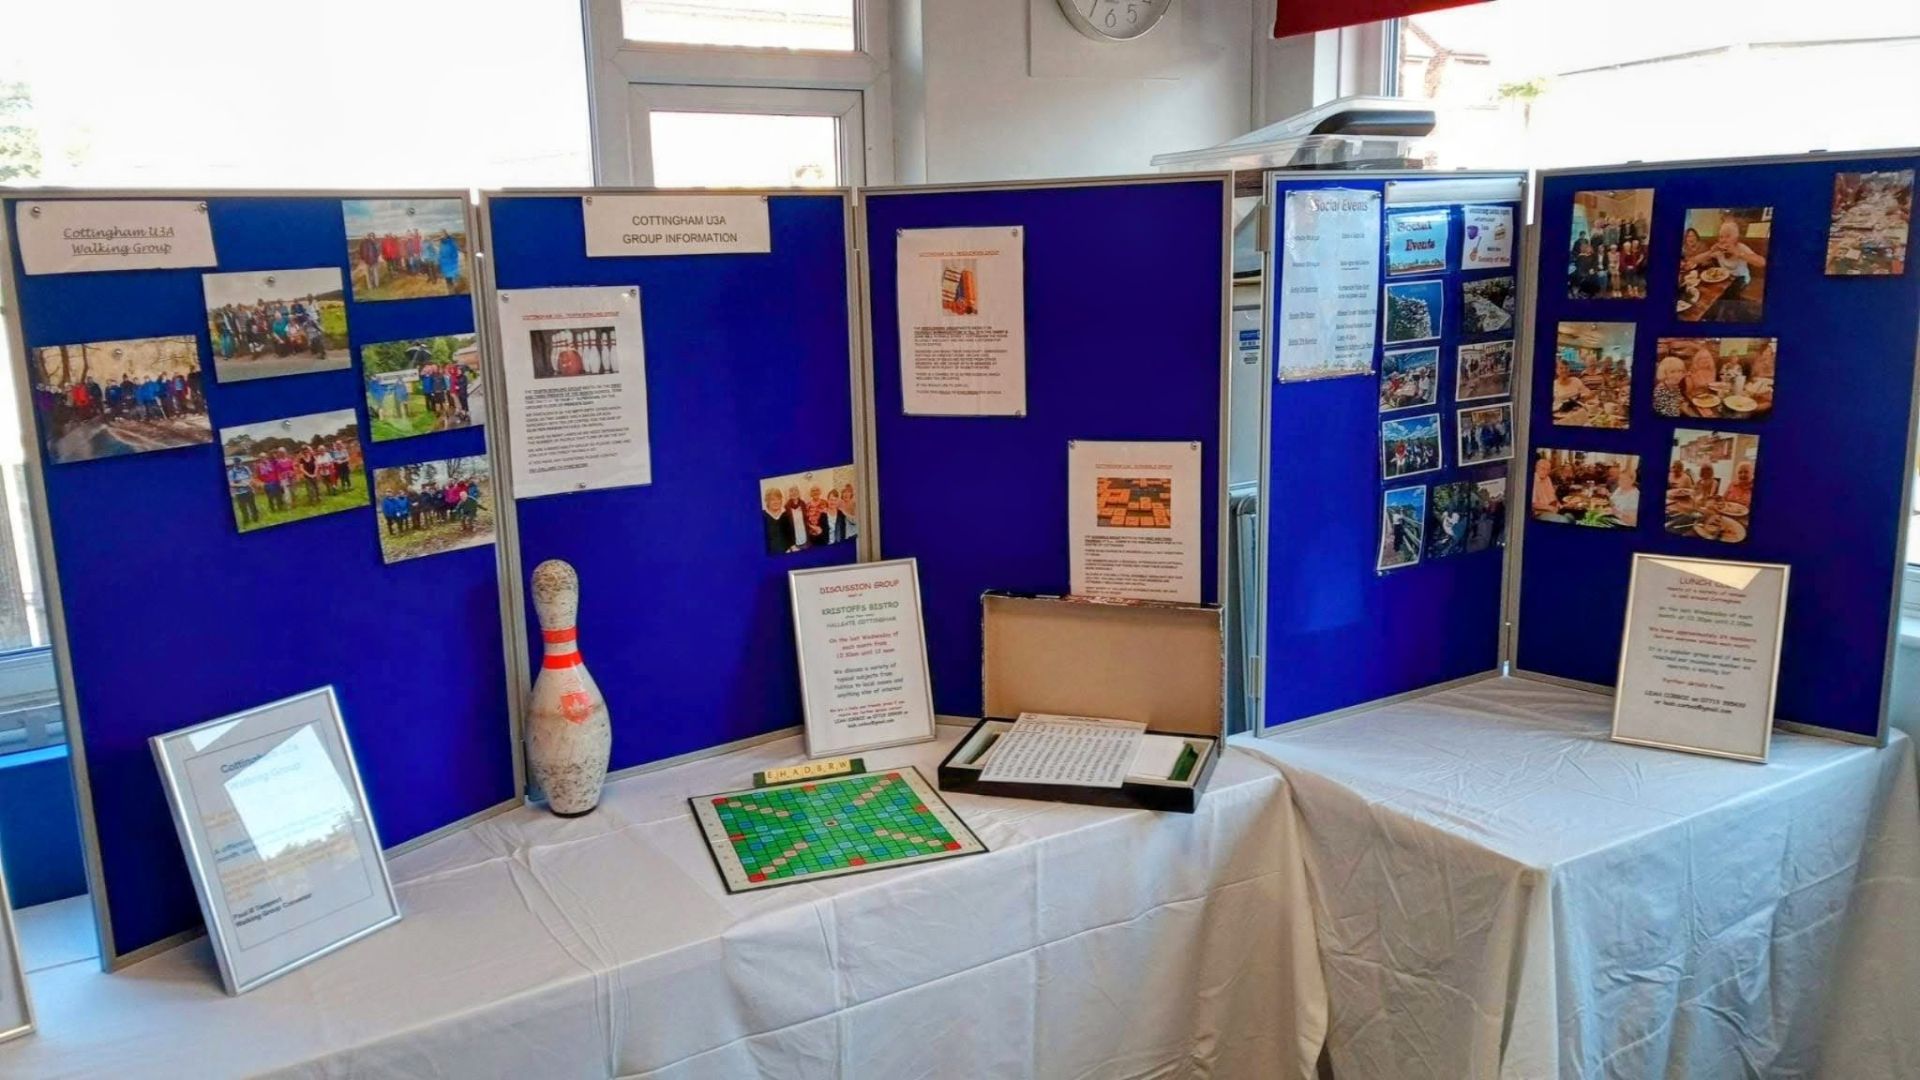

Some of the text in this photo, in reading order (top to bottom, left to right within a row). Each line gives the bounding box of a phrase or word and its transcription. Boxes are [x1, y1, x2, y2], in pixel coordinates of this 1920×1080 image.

[1104, 8, 1117, 28] 6
[1127, 4, 1138, 24] 5
[631, 215, 727, 226] COTTINGHAM U3A
[1396, 220, 1433, 232] Social
[63, 226, 176, 240] Cottingham U3A
[622, 232, 738, 245] GROUP INFORMATION
[71, 242, 173, 256] Walking Group
[1404, 238, 1437, 252] Events
[820, 579, 900, 594] DISCUSSION GROUP
[1679, 575, 1713, 587] LUNCH
[821, 604, 867, 616] KRISTOFFS
[868, 600, 900, 611] BISTRO
